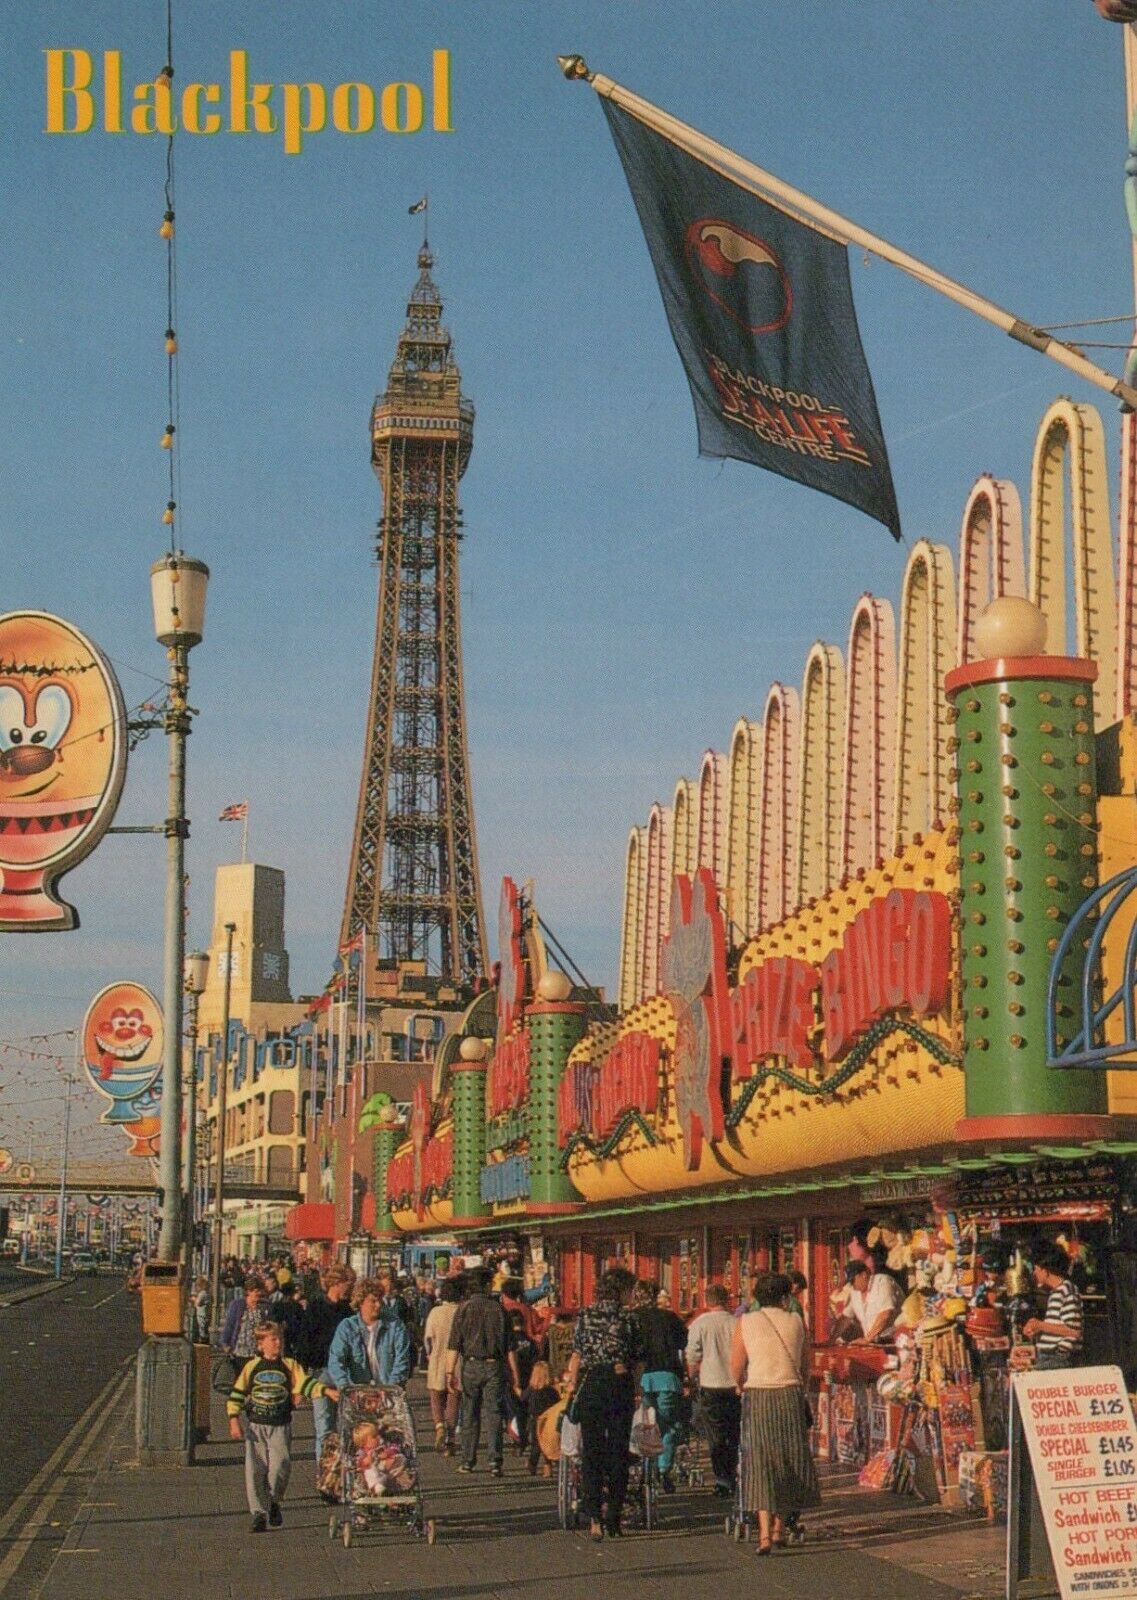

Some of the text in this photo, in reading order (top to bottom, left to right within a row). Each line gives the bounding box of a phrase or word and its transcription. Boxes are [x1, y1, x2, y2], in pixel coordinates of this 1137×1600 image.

[754, 425, 840, 461] CENTRE
[729, 888, 949, 1079] PRIZE BINGO
[1028, 1384, 1118, 1399] DOUBLE BURGER
[1031, 1398, 1124, 1419] SPECIAL £1.25
[1036, 1420, 1128, 1437] DOUBLE CHEESEBURGER
[1040, 1436, 1133, 1457] SPECIAL £1.45
[1047, 1458, 1135, 1477] SINGLE £1.05
[1054, 1467, 1095, 1481] BURGER
[1059, 1488, 1135, 1504] HOT BEEF
[1054, 1504, 1121, 1528] Sandwich
[1068, 1530, 1097, 1543] HOT
[1064, 1543, 1131, 1567] Sandwich
